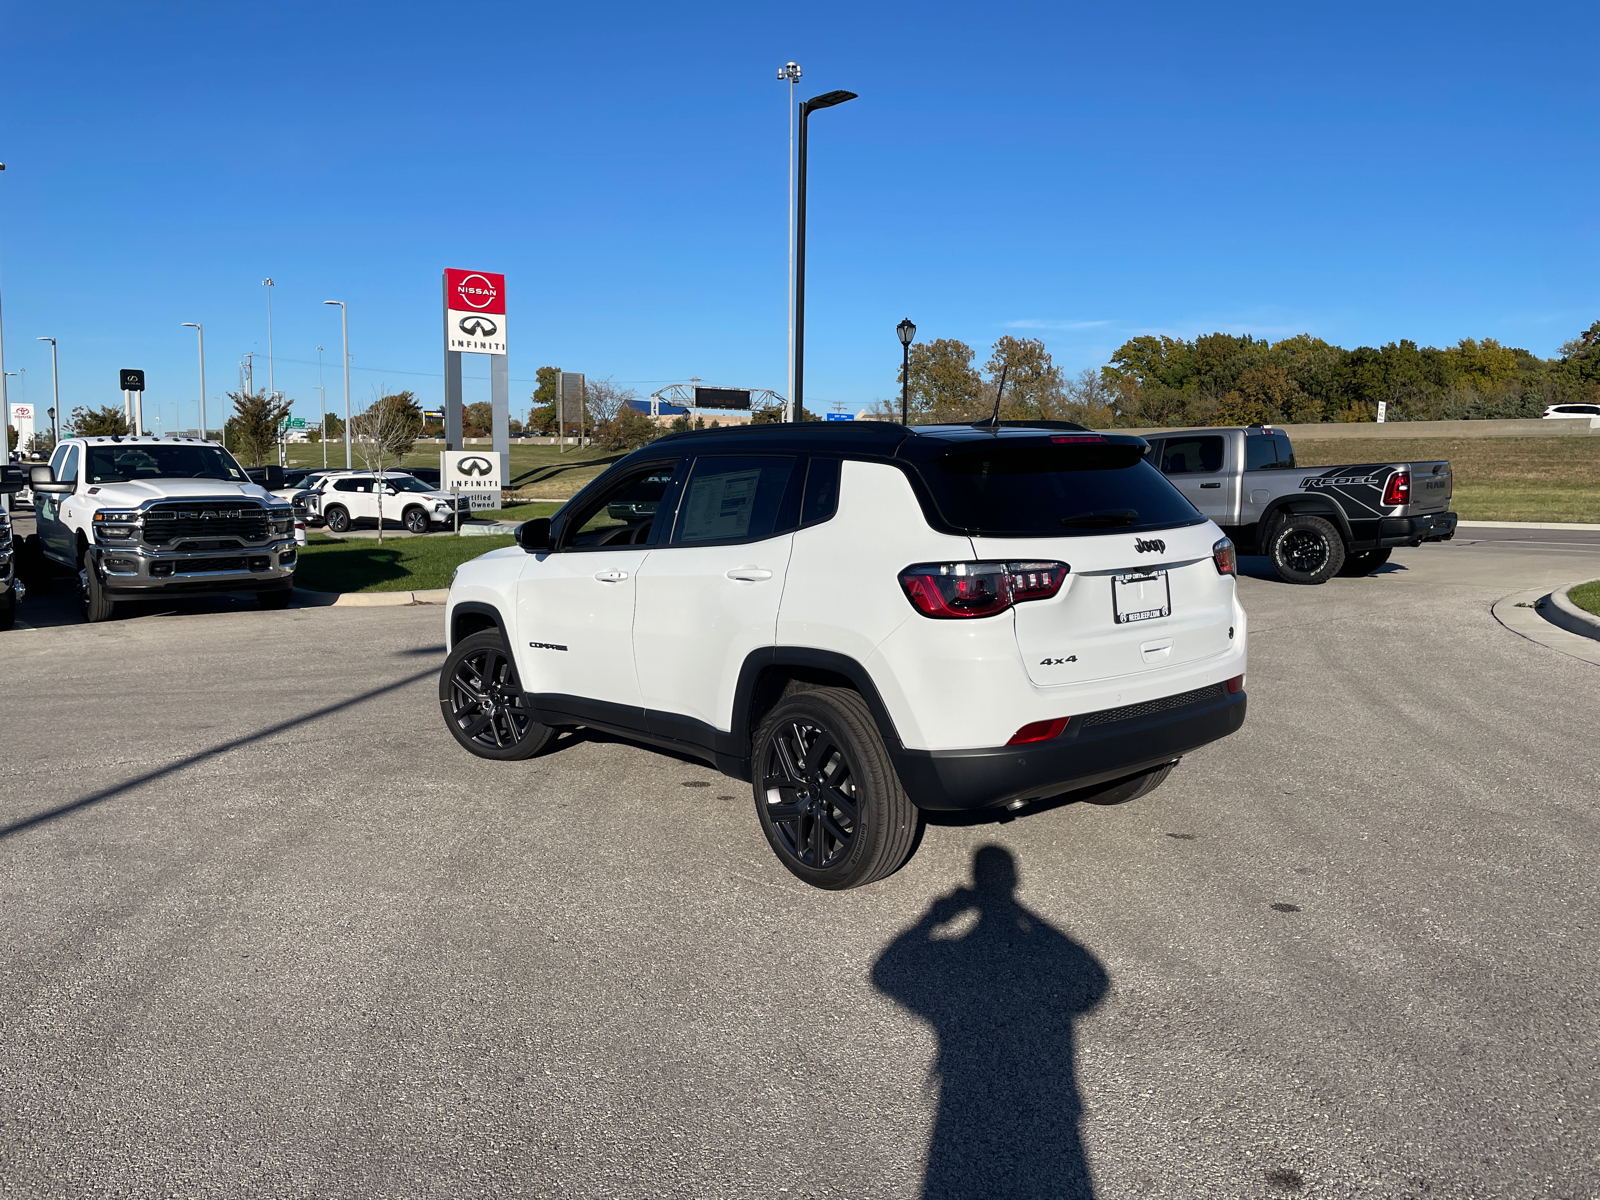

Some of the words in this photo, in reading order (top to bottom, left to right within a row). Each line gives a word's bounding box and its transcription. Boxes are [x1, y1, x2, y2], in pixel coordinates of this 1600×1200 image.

[458, 286, 497, 296] NISSAN
[451, 339, 505, 351] INFINITI
[1299, 475, 1379, 488] REBEL
[1426, 481, 1446, 489] RAM
[178, 510, 239, 519] RAM
[1134, 537, 1166, 555] Jeep
[1040, 655, 1078, 666] 4x4
